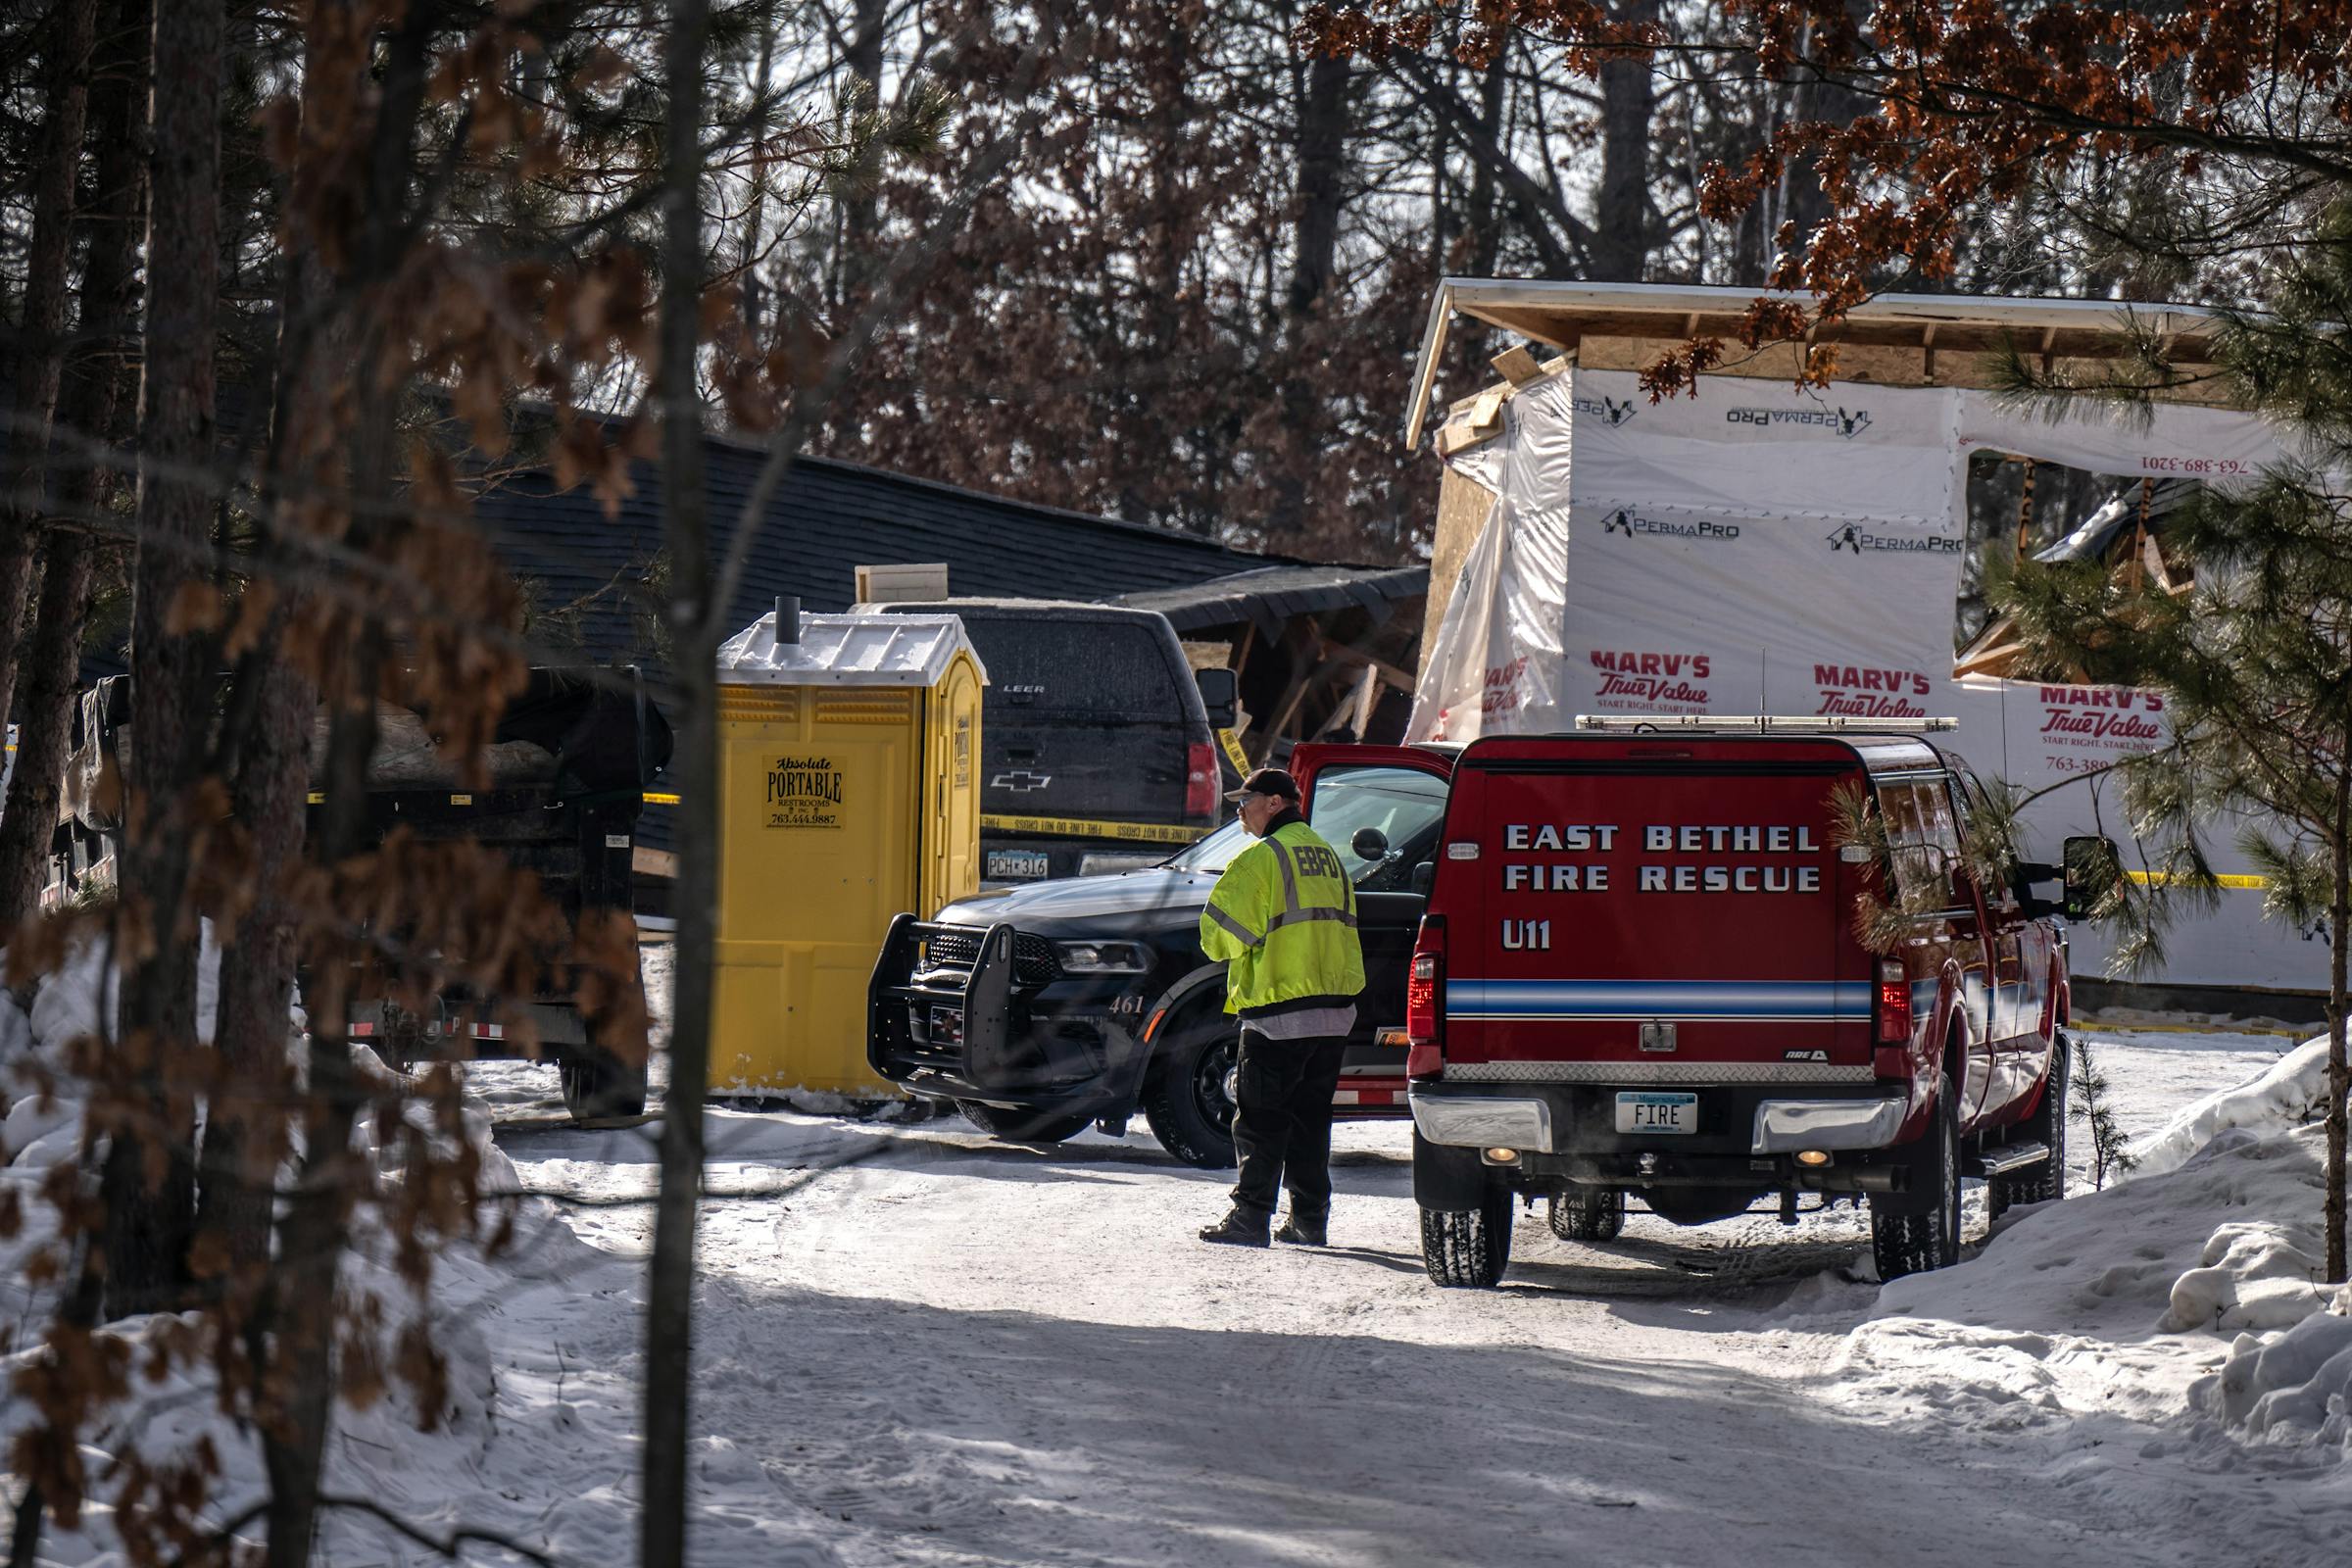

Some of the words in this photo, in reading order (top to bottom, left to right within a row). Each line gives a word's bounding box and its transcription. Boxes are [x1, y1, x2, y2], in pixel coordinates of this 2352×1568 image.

[2141, 456, 2250, 474] 763-389-3201
[1591, 650, 1710, 679] MARV'S
[1814, 664, 1931, 695] MARV'S
[2039, 687, 2163, 711] MARV'S
[2042, 736, 2068, 746] START
[776, 757, 832, 770] Absolute
[767, 771, 842, 804] PORTABLE
[778, 799, 831, 808] RESTROOMS
[771, 813, 836, 824] 763.444.9887
[1505, 824, 1619, 852] EAST
[1645, 825, 1820, 854] BETHEL
[1292, 846, 1339, 879] EBFD
[1504, 864, 1609, 893] FIRE
[1640, 865, 1821, 894] RESCUE
[1502, 918, 1550, 951] U11
[1108, 995, 1145, 1014] 461
[1635, 1104, 1680, 1125] FIRE
